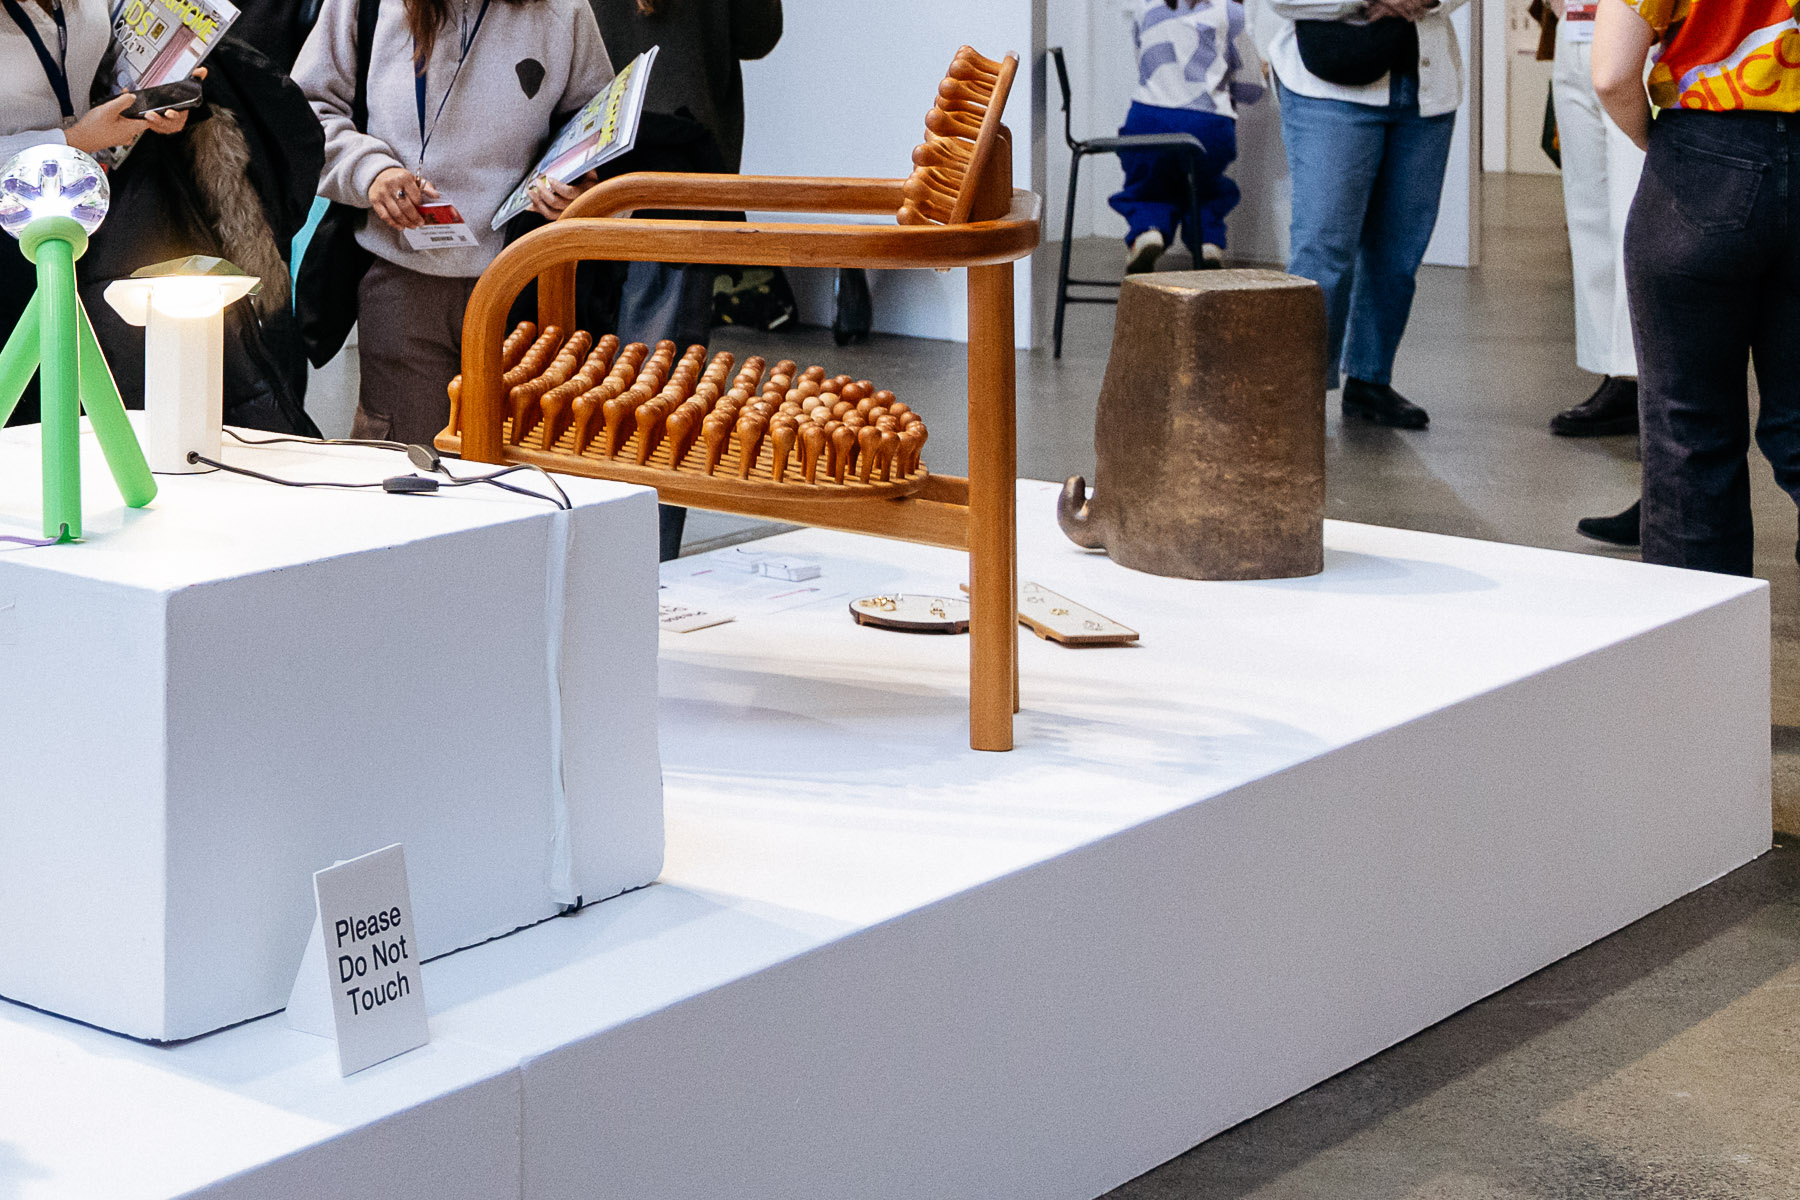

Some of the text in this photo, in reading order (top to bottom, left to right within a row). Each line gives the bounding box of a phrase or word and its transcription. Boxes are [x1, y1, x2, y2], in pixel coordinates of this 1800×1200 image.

[335, 906, 402, 948] Please
[338, 935, 409, 984] Do Not
[347, 971, 410, 1016] Touch
